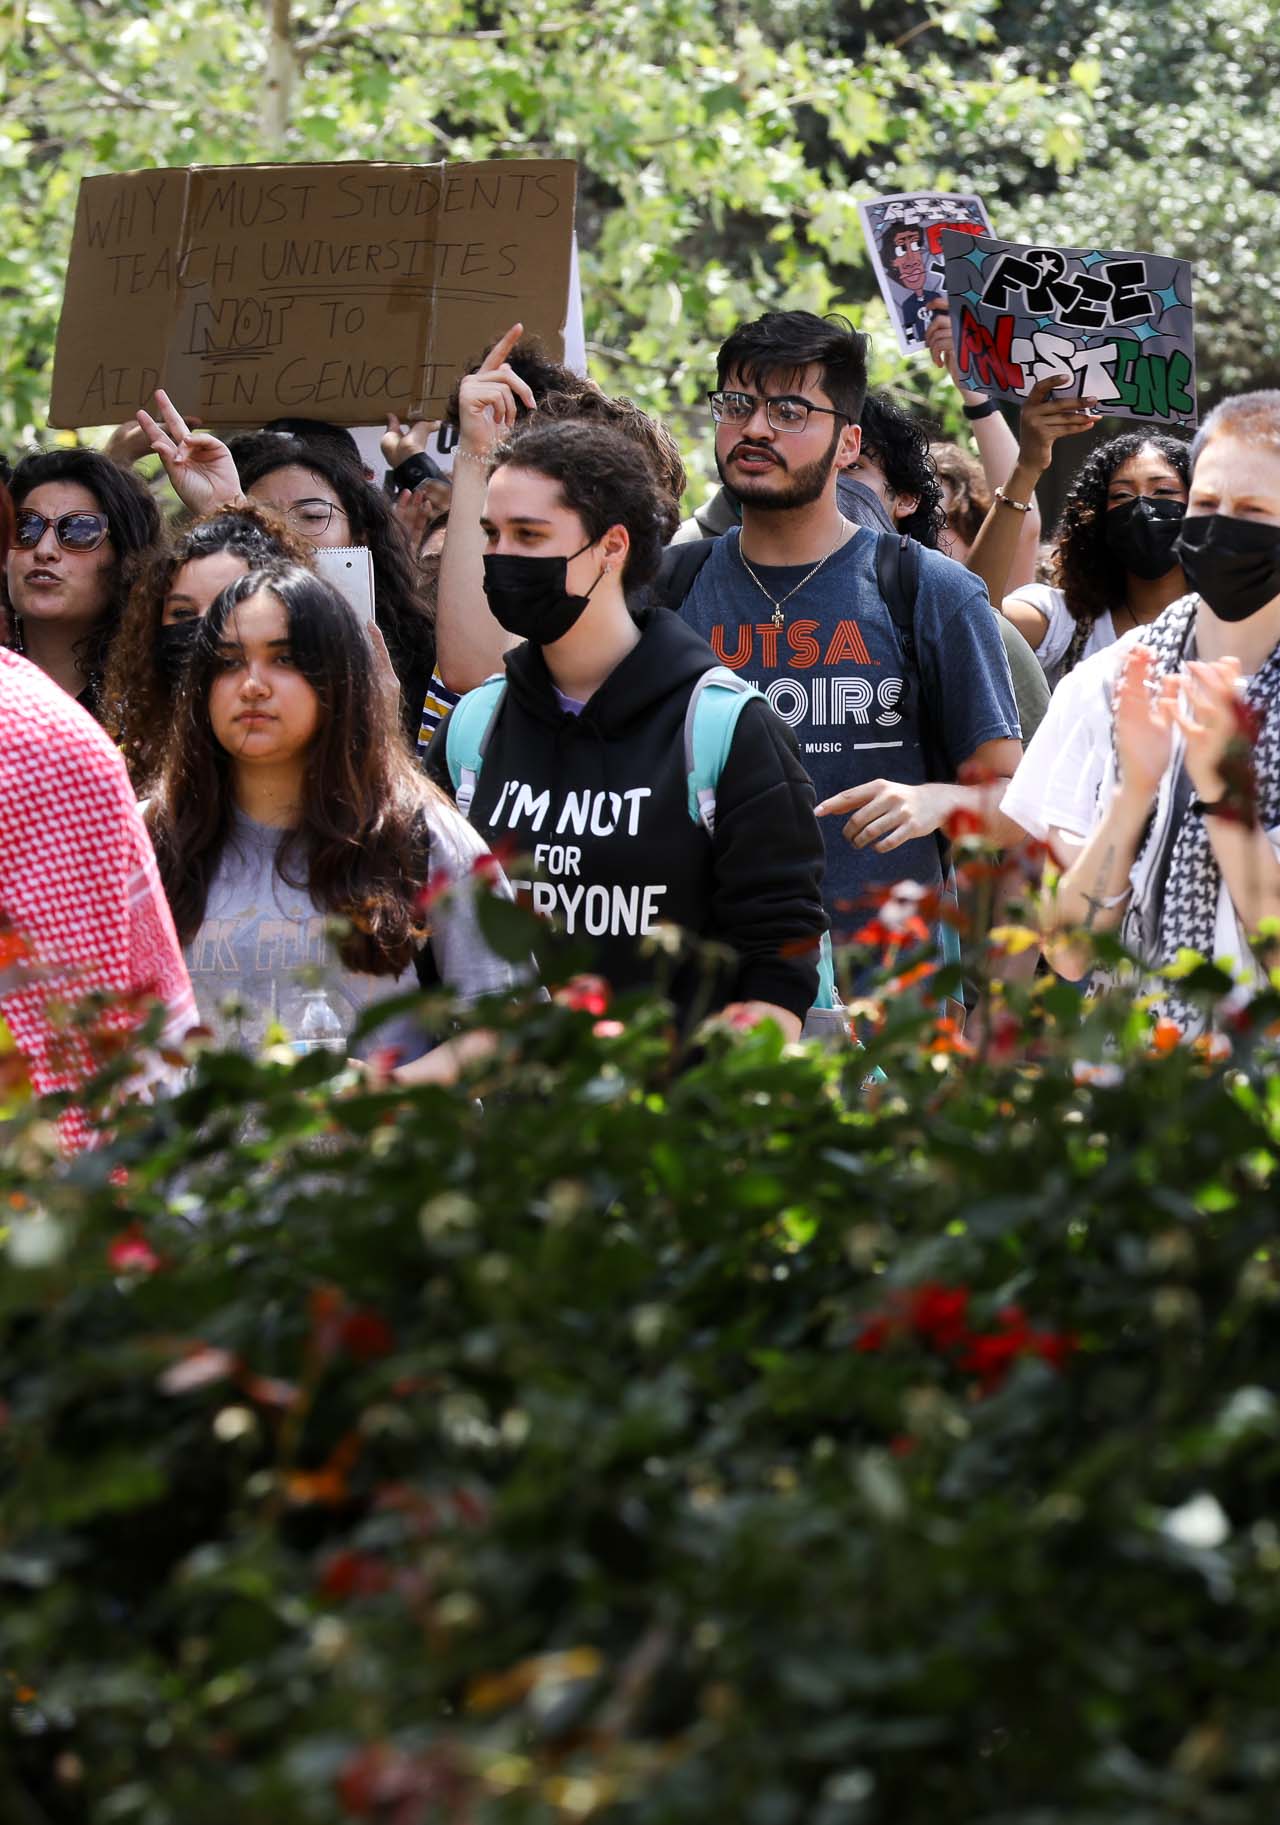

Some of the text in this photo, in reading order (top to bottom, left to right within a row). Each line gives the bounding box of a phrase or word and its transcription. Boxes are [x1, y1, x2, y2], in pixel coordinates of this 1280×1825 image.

[85, 175, 559, 248] WHY MUST STUDENTS
[107, 240, 520, 296] TEACH UNIVERSITES
[979, 248, 1156, 331] FREE
[190, 297, 365, 354] NOT TO
[79, 357, 459, 413] AID IN GENOCI
[959, 304, 1194, 418] PALESTINE
[710, 619, 872, 670] UTSA
[747, 677, 904, 727] OIRS
[805, 742, 843, 753] MUSIC
[489, 781, 652, 836] I'M NOT
[533, 844, 582, 876] FOR
